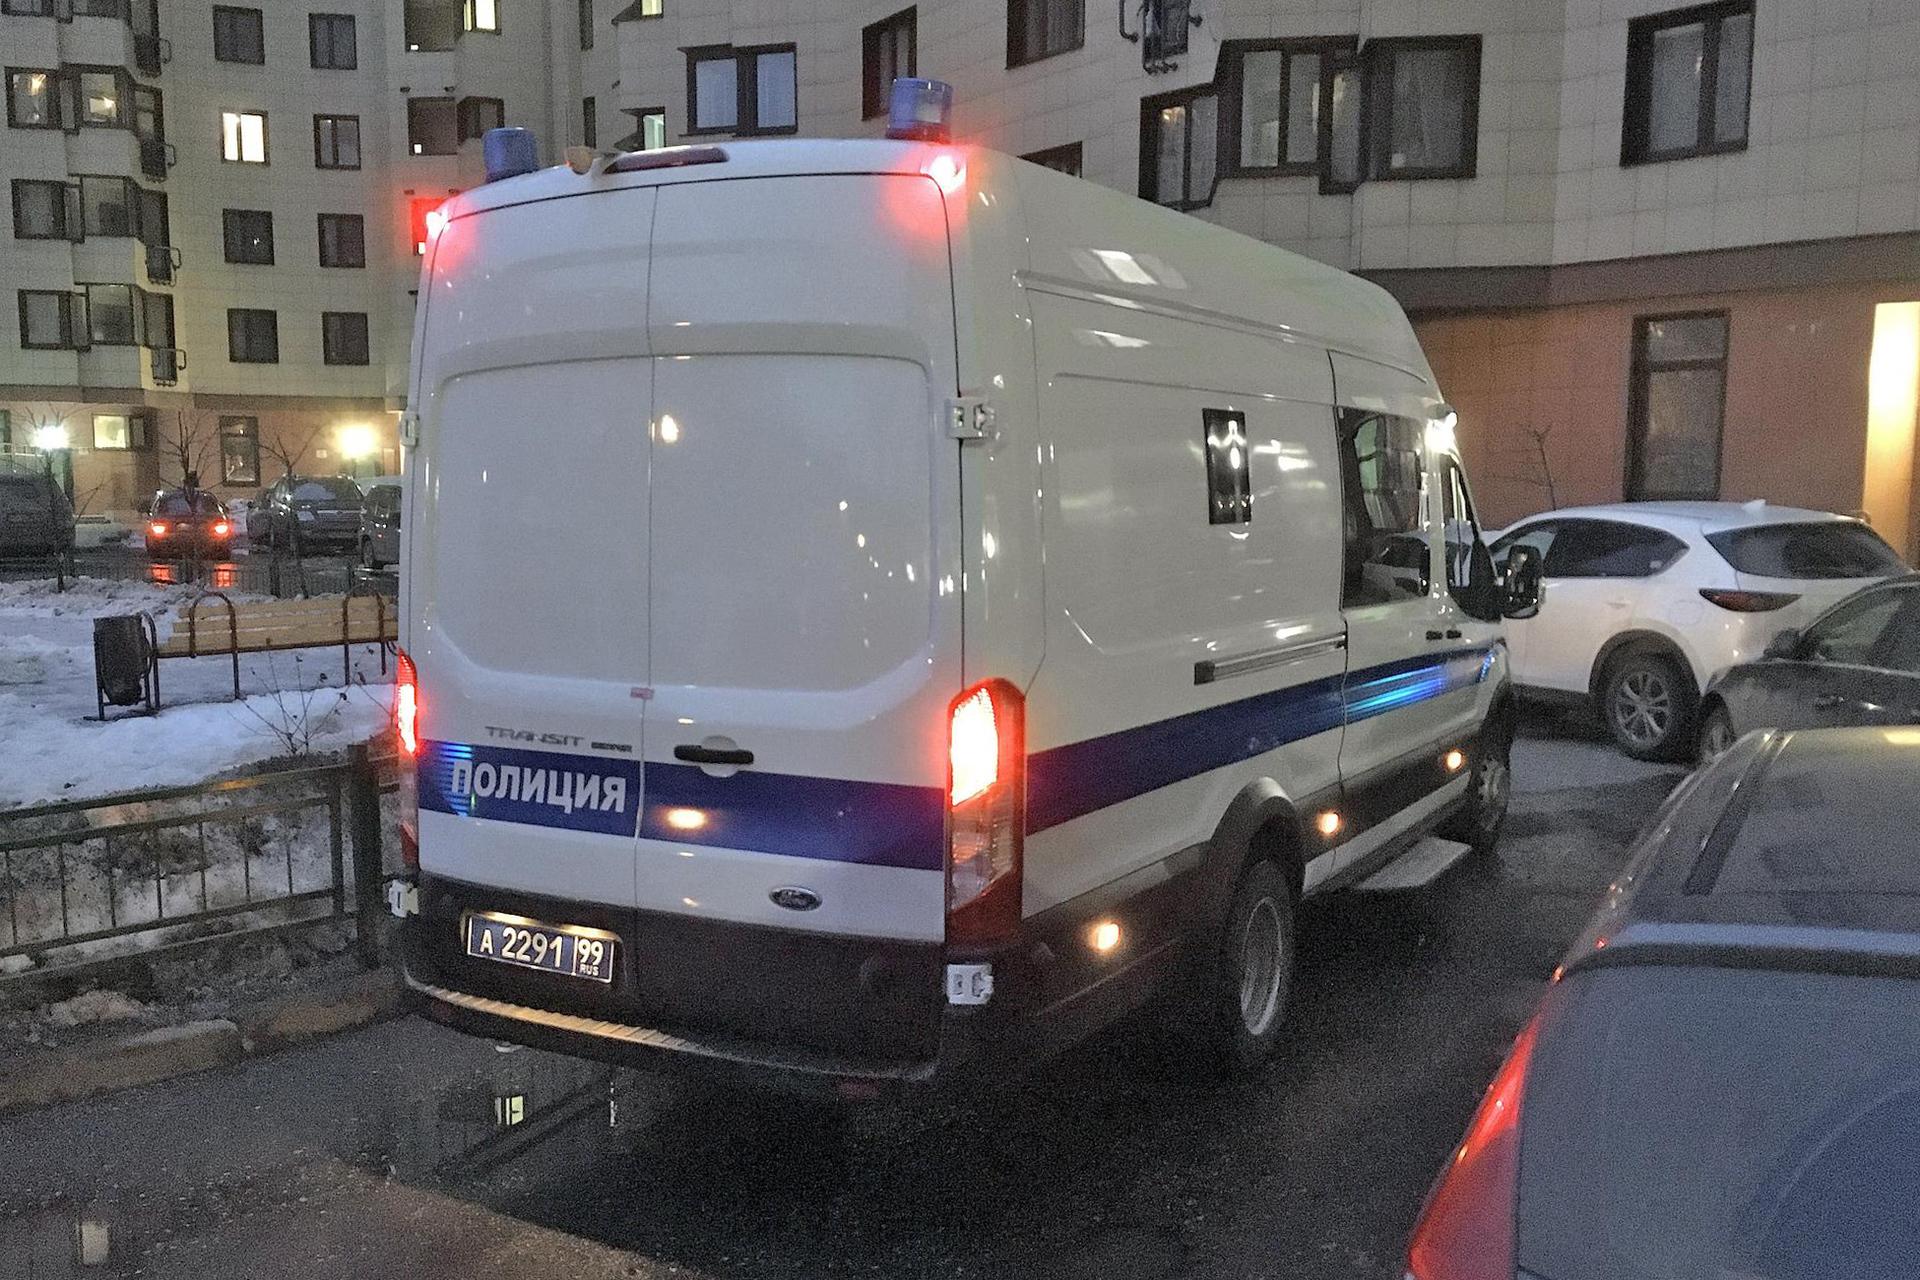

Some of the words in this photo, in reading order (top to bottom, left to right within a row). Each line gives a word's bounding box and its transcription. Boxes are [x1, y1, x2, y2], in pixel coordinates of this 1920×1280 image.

[484, 726, 584, 747] TRANSIT
[451, 760, 627, 814] ПОЛИЦИЯ
[501, 926, 563, 968] 2291
[578, 939, 604, 966] 99
[579, 963, 600, 977] RUS
